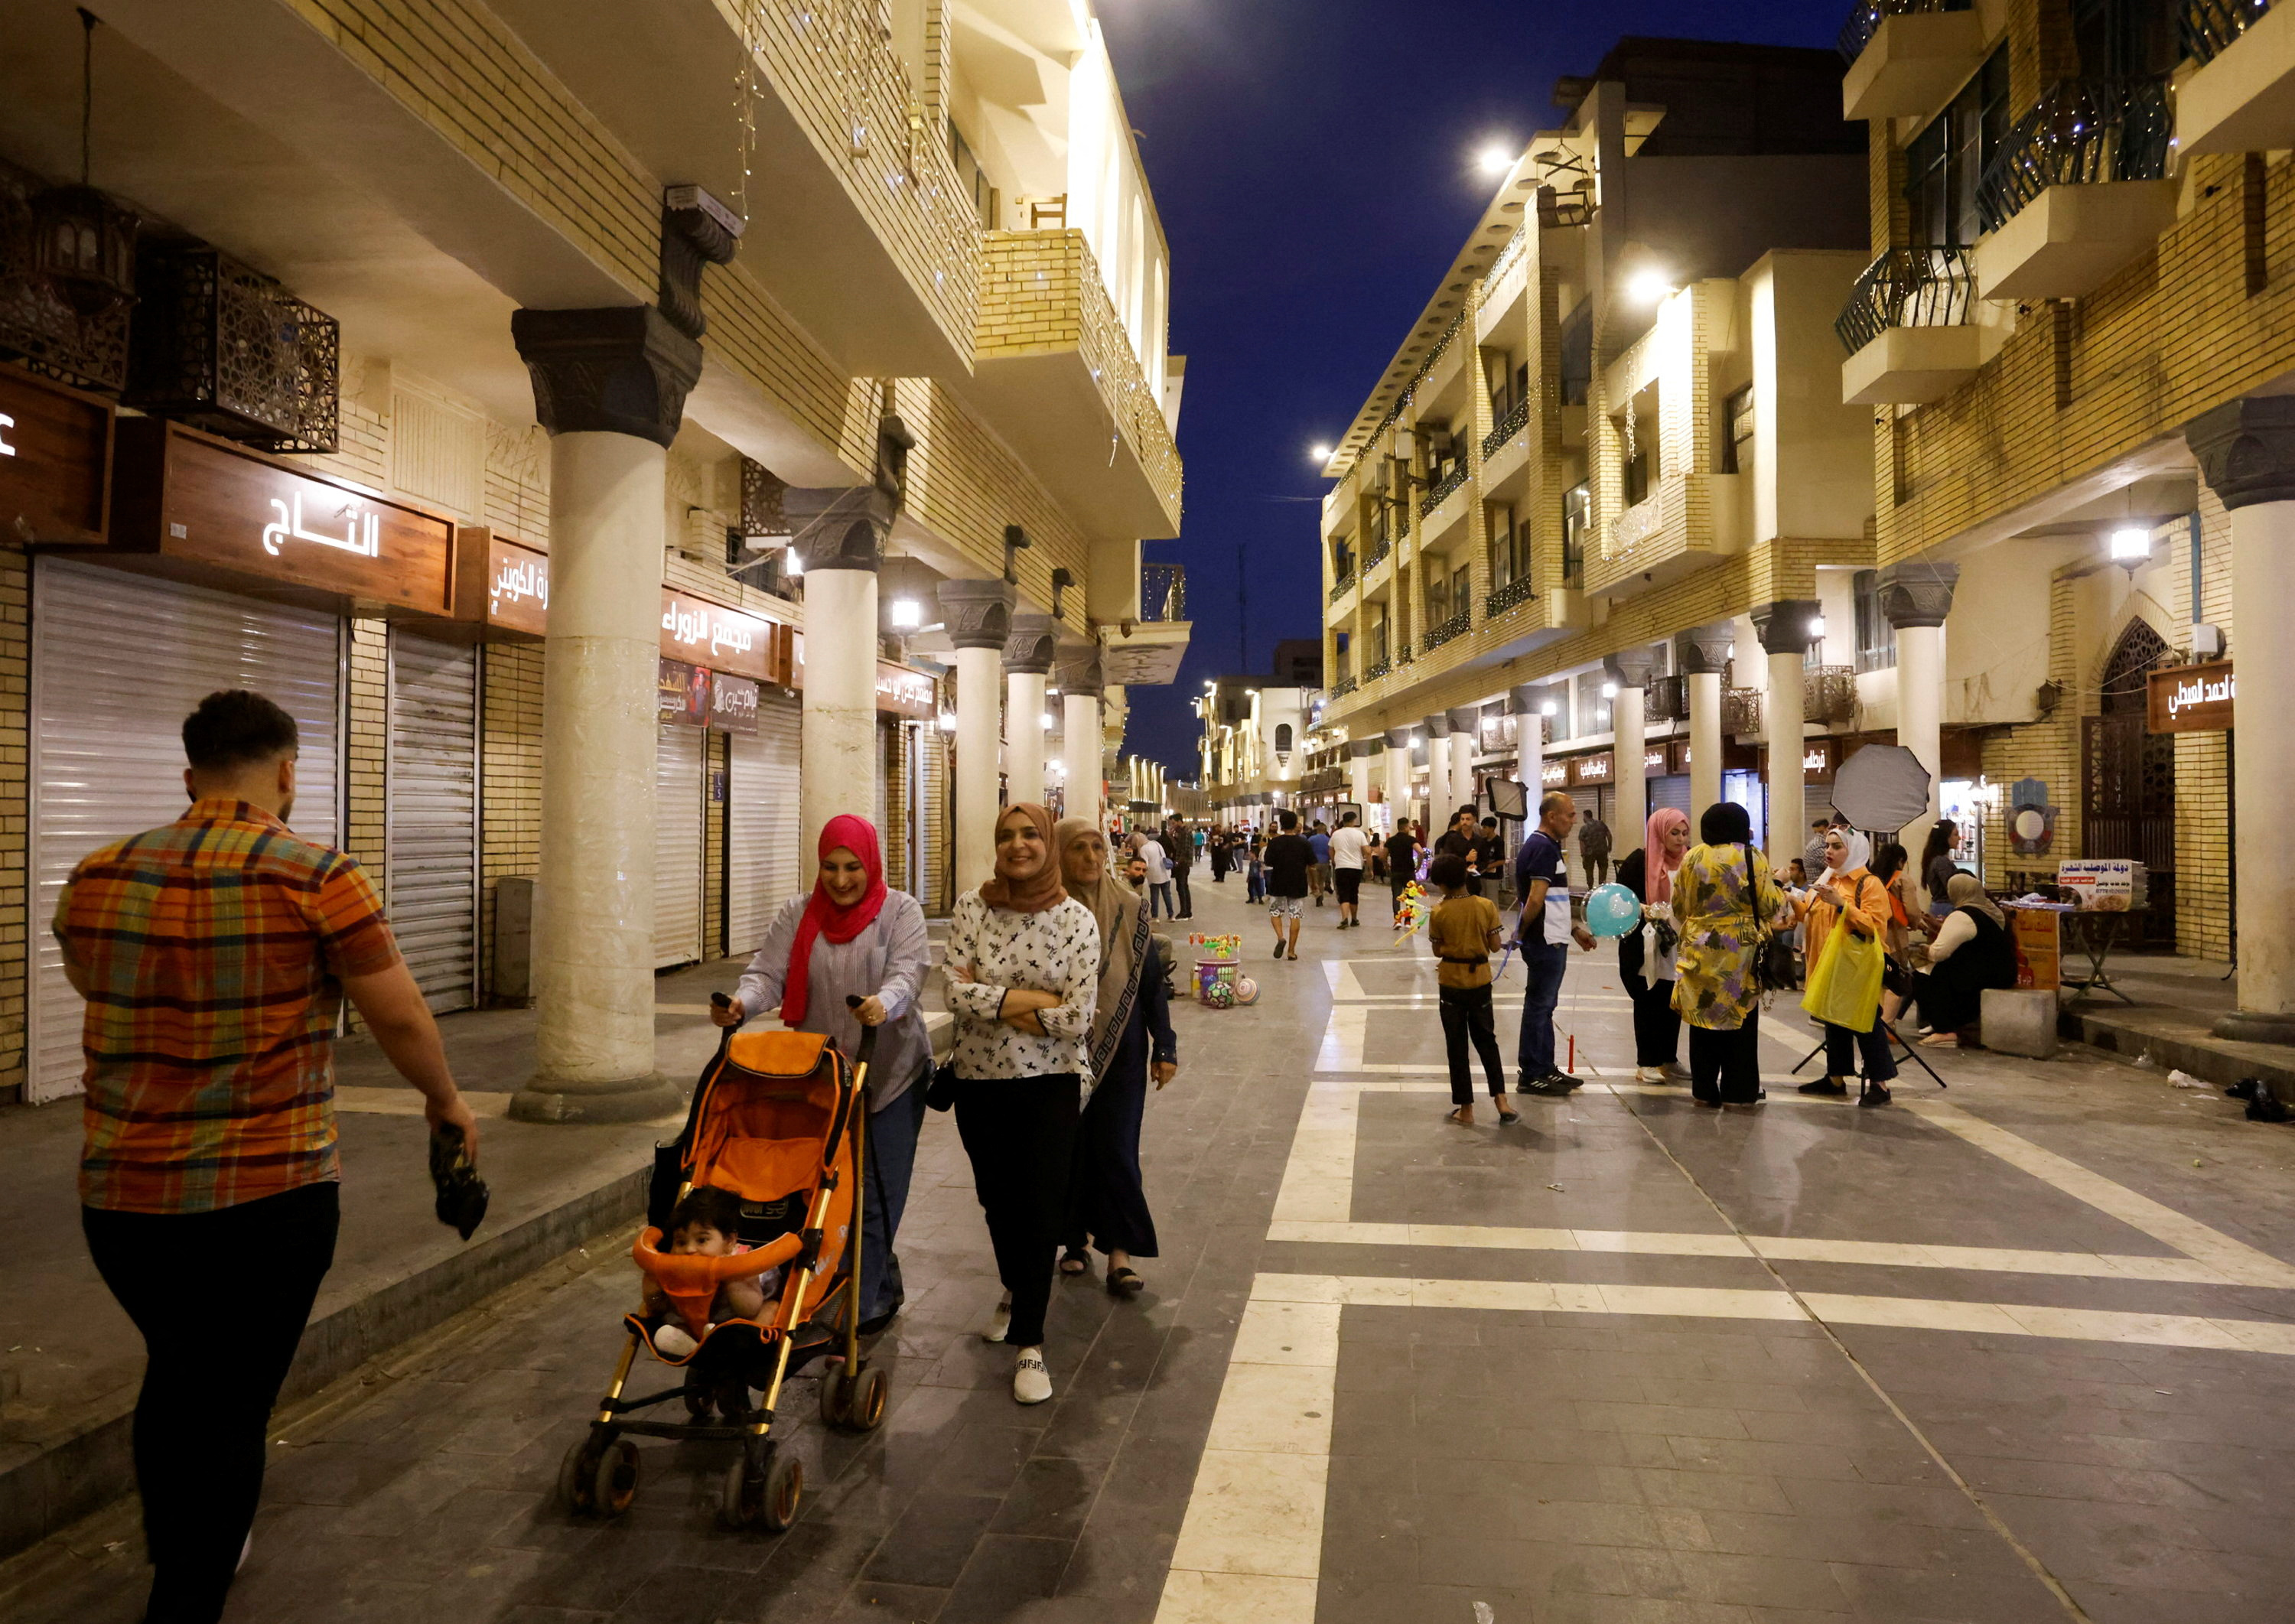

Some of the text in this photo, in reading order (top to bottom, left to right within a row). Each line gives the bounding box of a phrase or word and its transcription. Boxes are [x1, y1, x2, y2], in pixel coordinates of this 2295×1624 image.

[263, 490, 379, 558] التاج
[490, 557, 534, 608] الكويتي
[661, 600, 752, 656] مجمع الزوراء
[2204, 673, 2229, 701] احمد
[1802, 749, 1826, 773] قرطاسي
